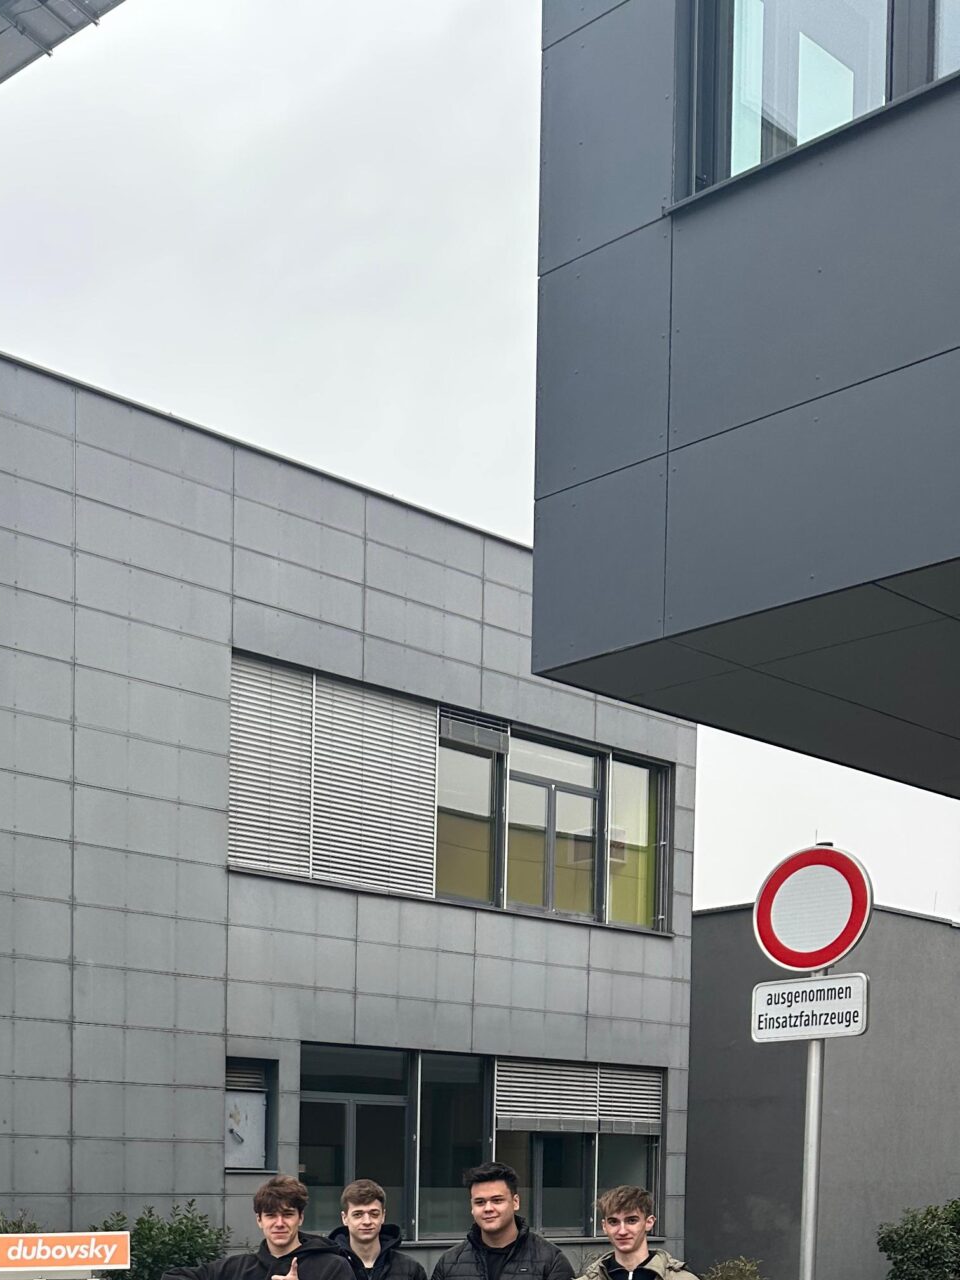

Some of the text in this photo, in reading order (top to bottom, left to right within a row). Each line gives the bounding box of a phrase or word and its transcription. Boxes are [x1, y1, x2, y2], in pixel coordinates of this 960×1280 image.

[766, 985, 852, 1007] ausgenommen
[757, 1010, 859, 1030] Einsatzfahrzeuge
[7, 1238, 118, 1263] dubovsky
